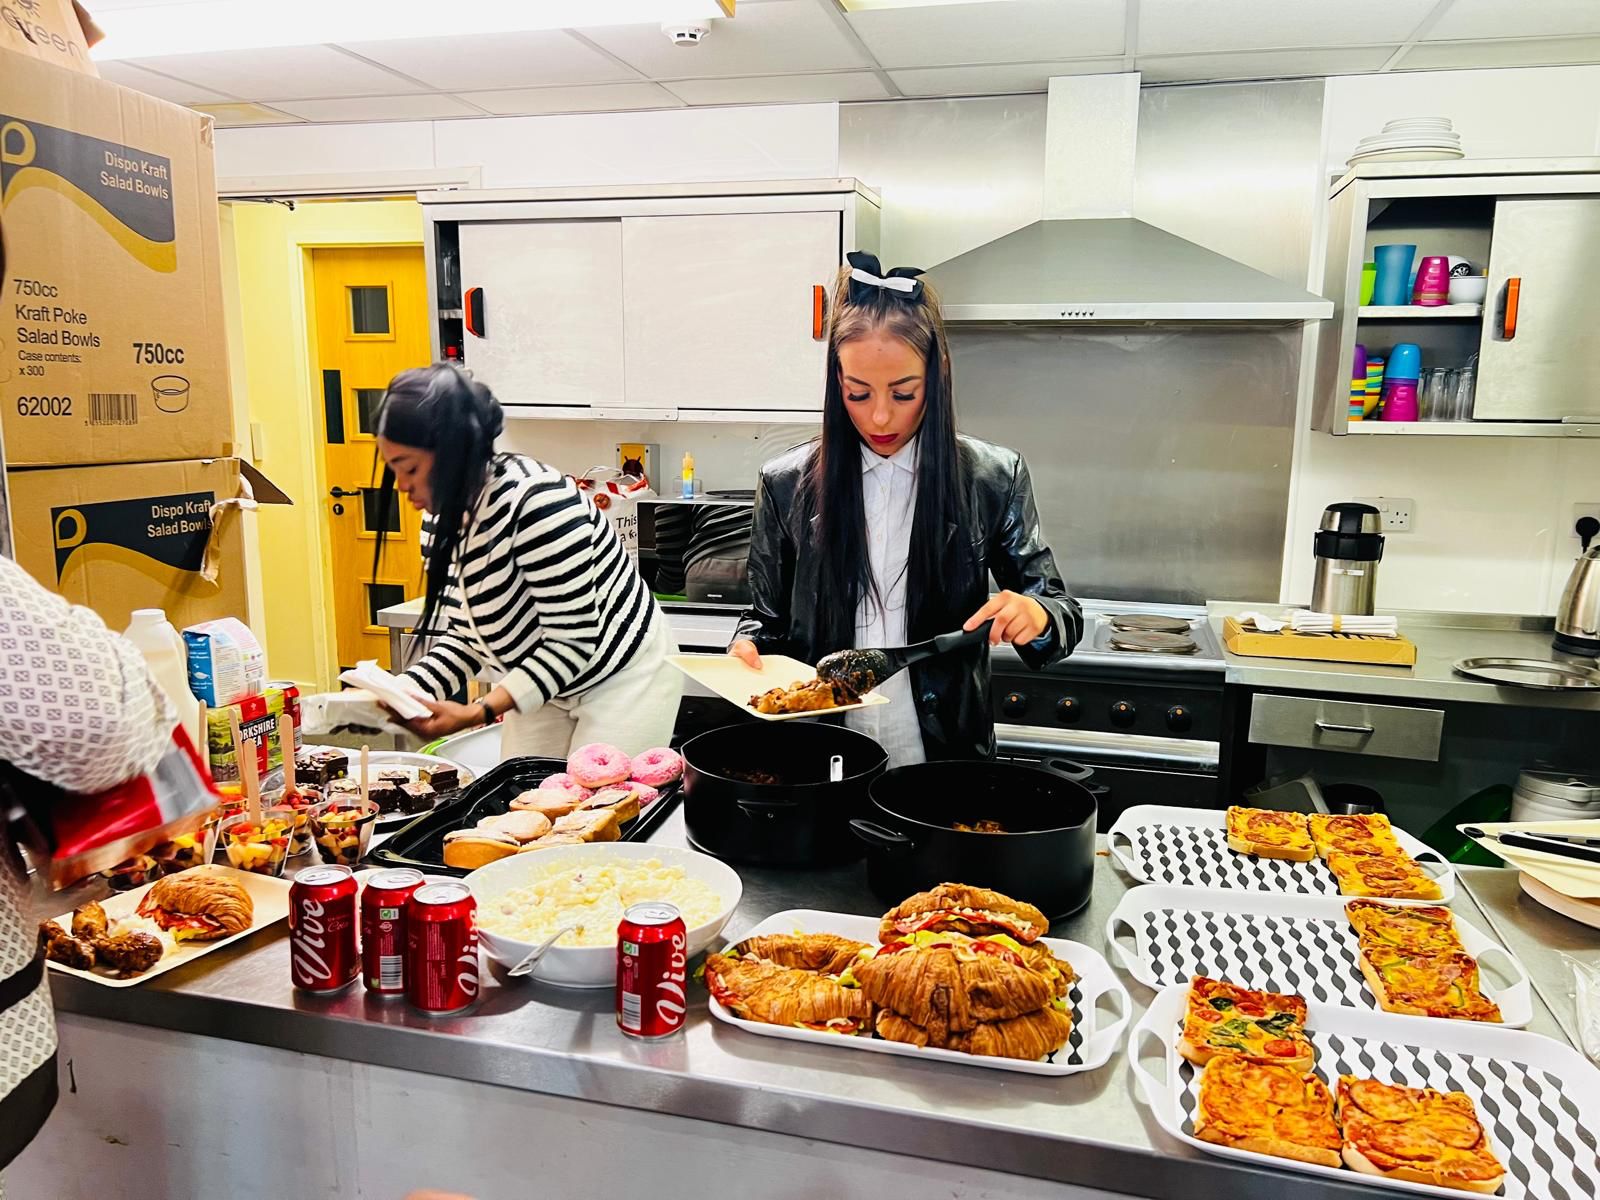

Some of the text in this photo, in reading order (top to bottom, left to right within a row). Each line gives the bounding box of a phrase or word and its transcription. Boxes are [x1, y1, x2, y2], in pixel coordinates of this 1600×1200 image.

[0, 6, 84, 61] Green
[104, 151, 168, 180] Dispo Kraft
[100, 170, 169, 200] Salad Bowls
[13, 279, 58, 298] 750cc
[15, 304, 88, 325] Kraft Poke
[17, 327, 101, 348] Salad Bowls
[18, 349, 43, 361] Case
[133, 342, 185, 364] 750cc
[19, 365, 45, 377] x 300
[17, 396, 73, 417] 62002
[151, 504, 184, 520] Dispo
[615, 514, 637, 529] This
[147, 521, 179, 538] Salad
[239, 718, 275, 742] ORKSHIRE
[293, 898, 332, 985] Vive
[656, 931, 687, 1026] Vive
